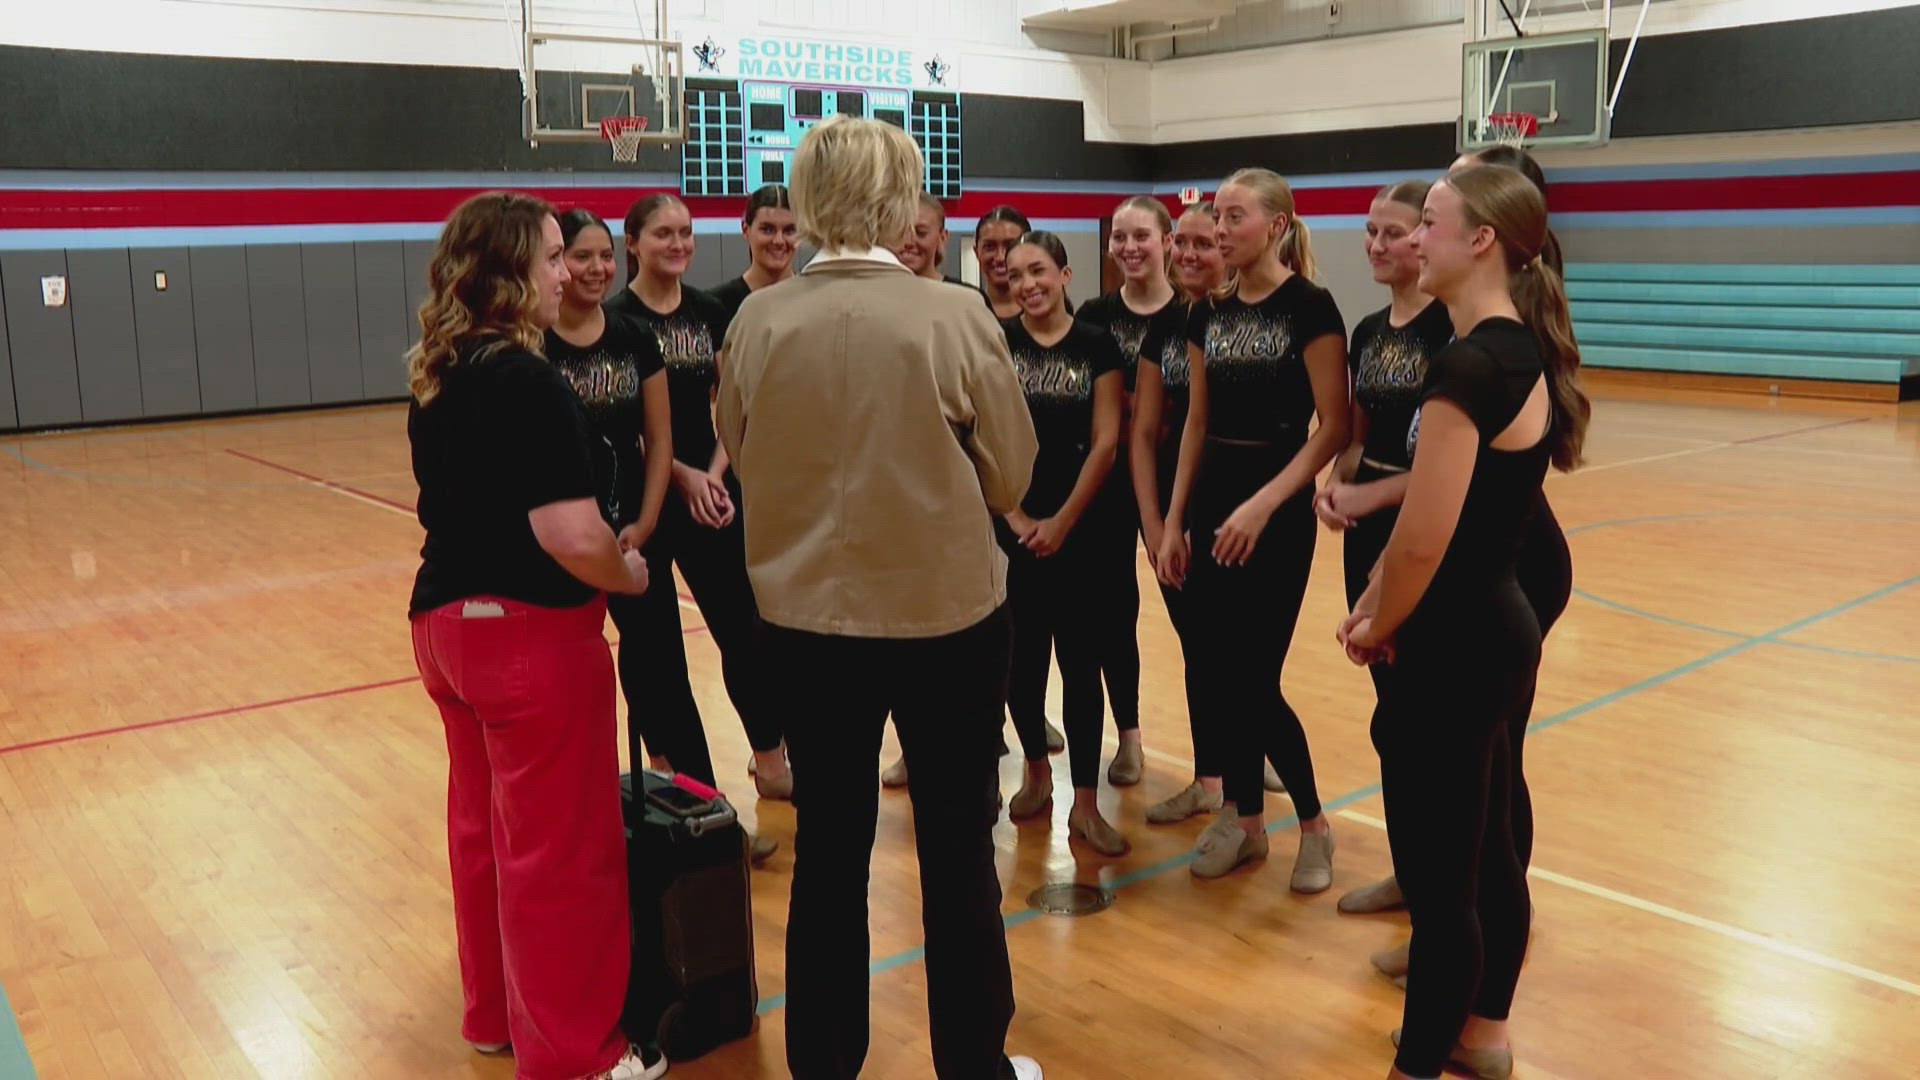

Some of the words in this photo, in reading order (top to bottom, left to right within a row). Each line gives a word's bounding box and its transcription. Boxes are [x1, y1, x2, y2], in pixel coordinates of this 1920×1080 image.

[738, 38, 912, 67] SOUTHSIDE
[738, 58, 912, 85] MAVERICKS
[752, 85, 782, 99] HOME
